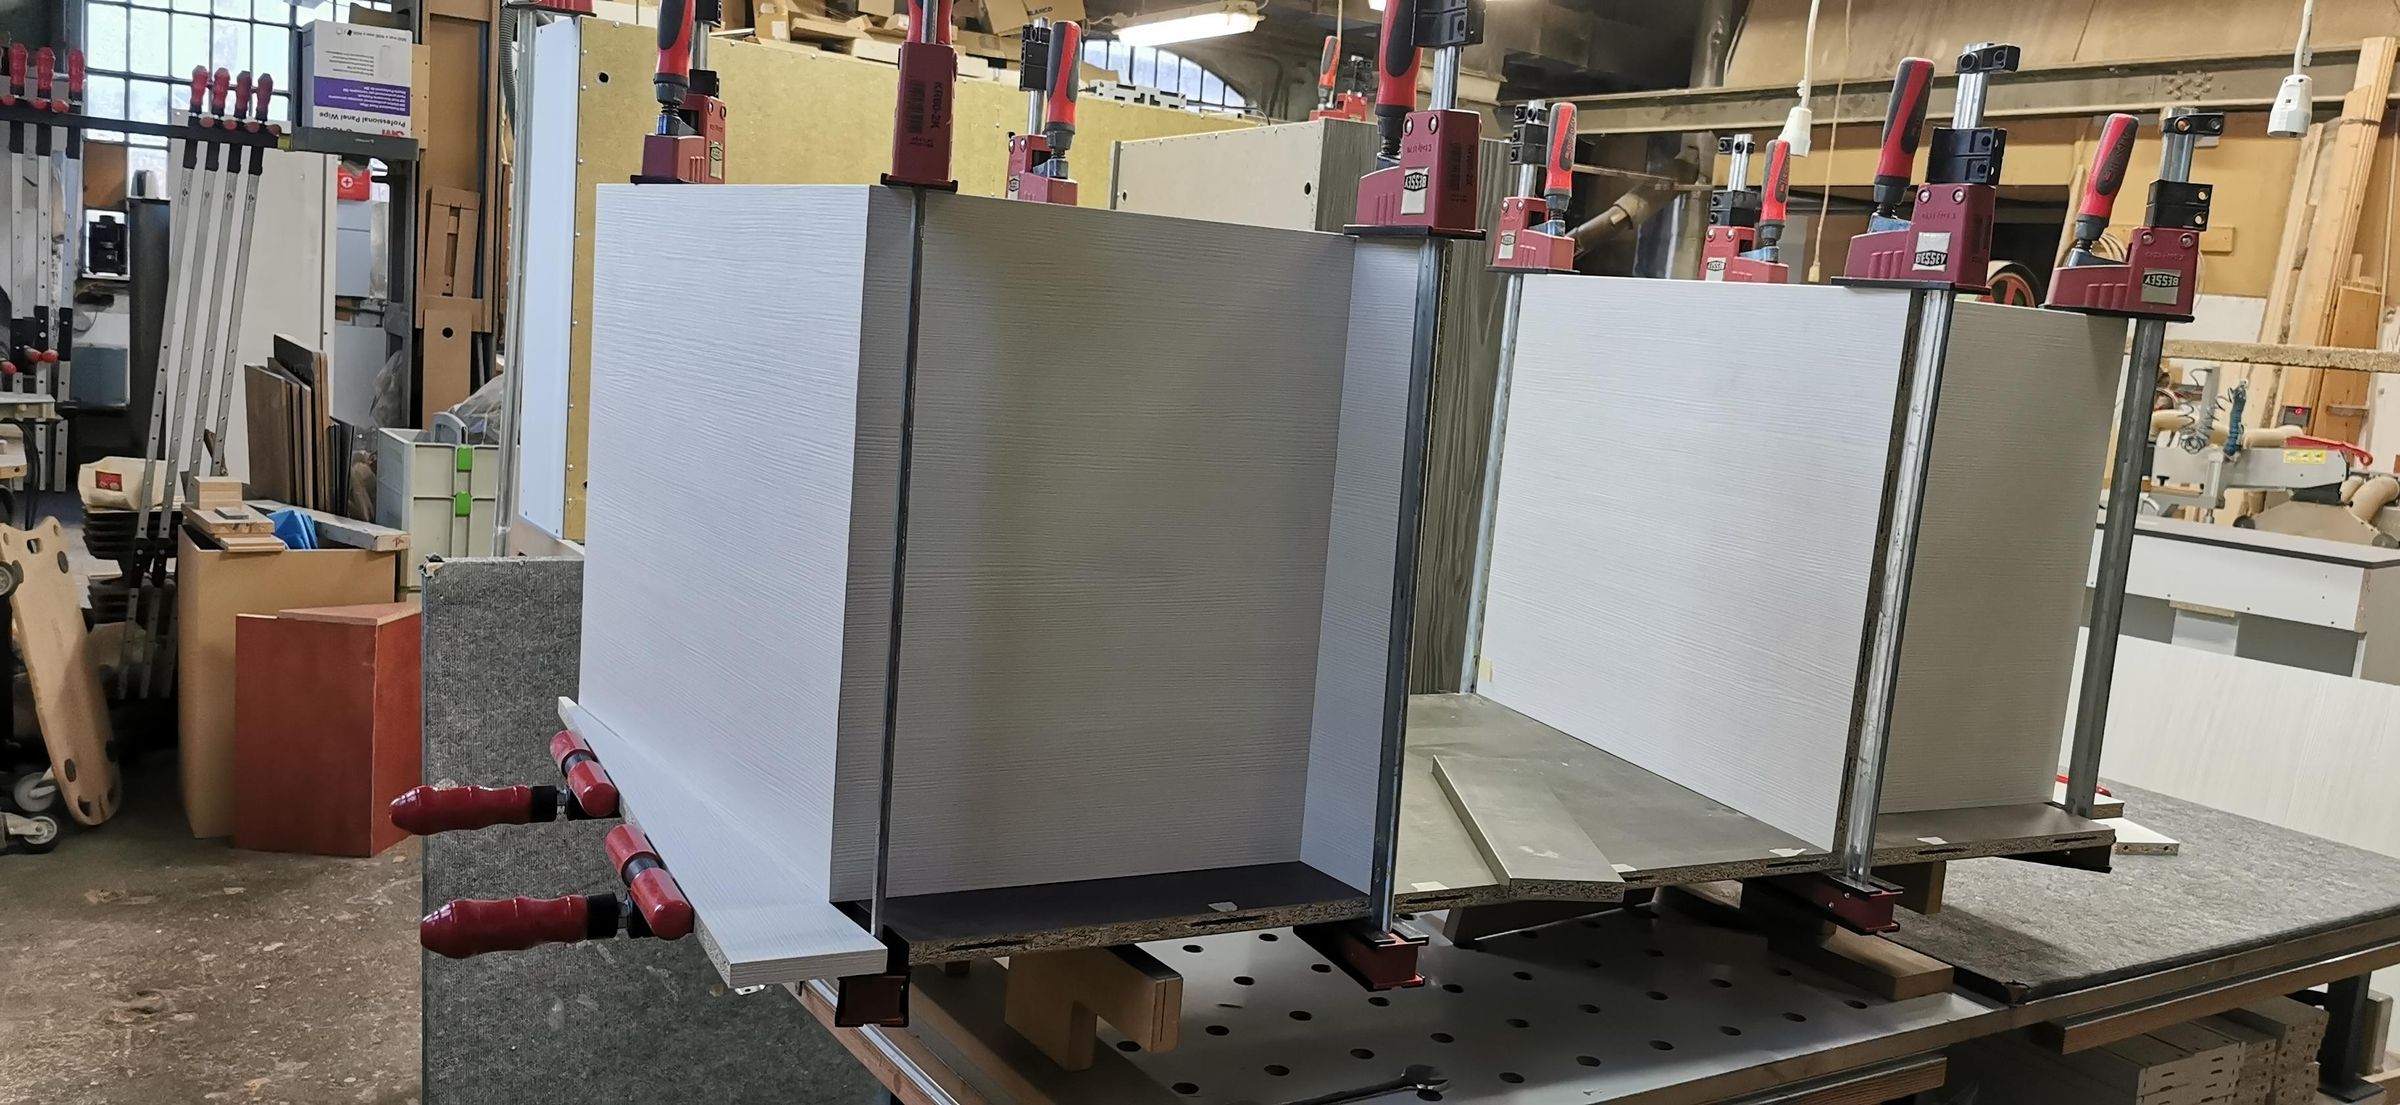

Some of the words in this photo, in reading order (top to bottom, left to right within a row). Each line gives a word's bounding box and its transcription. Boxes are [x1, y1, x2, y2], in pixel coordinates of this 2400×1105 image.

[319, 111, 339, 120] Wipe
[340, 114, 361, 123] Panel
[362, 116, 406, 128] Professional
[1404, 174, 1427, 190] BESSEY
[1915, 252, 1946, 265] BESSEY
[2144, 274, 2179, 287] BESSEY
